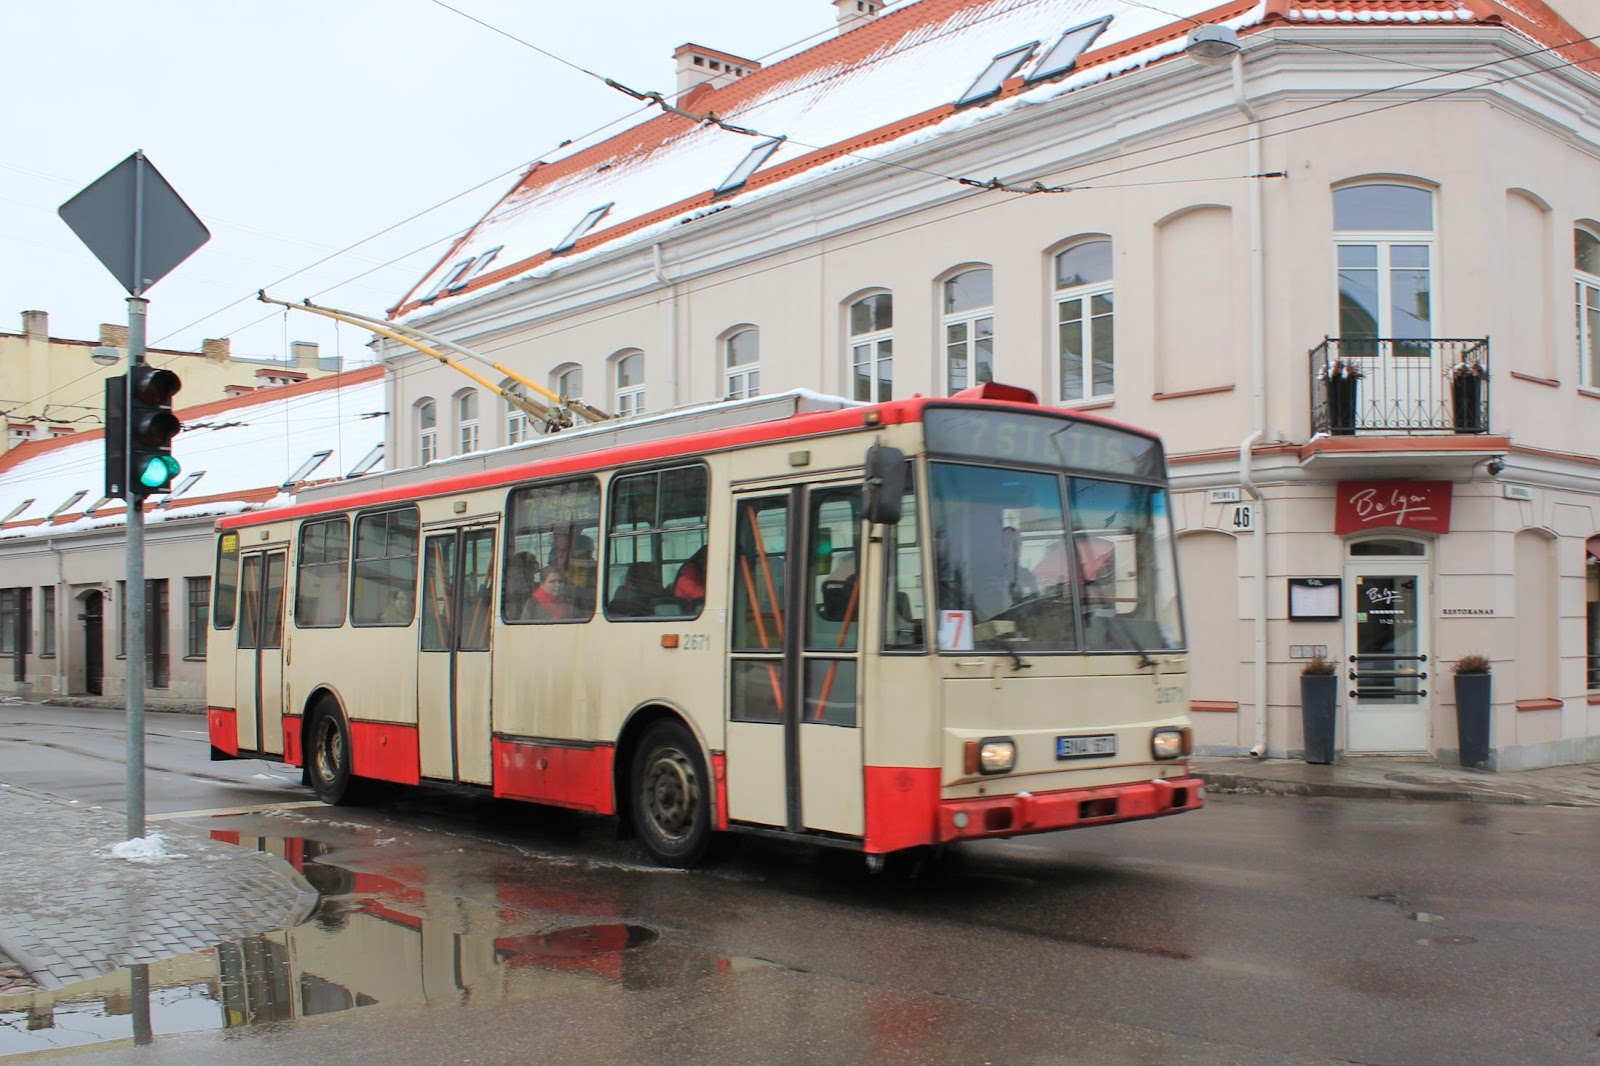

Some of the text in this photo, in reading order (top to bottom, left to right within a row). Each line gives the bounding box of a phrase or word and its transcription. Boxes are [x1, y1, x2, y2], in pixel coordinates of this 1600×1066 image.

[1233, 507, 1250, 527] 46
[1349, 488, 1431, 525] Belgai
[683, 634, 711, 651] 2671
[946, 612, 965, 649] 7
